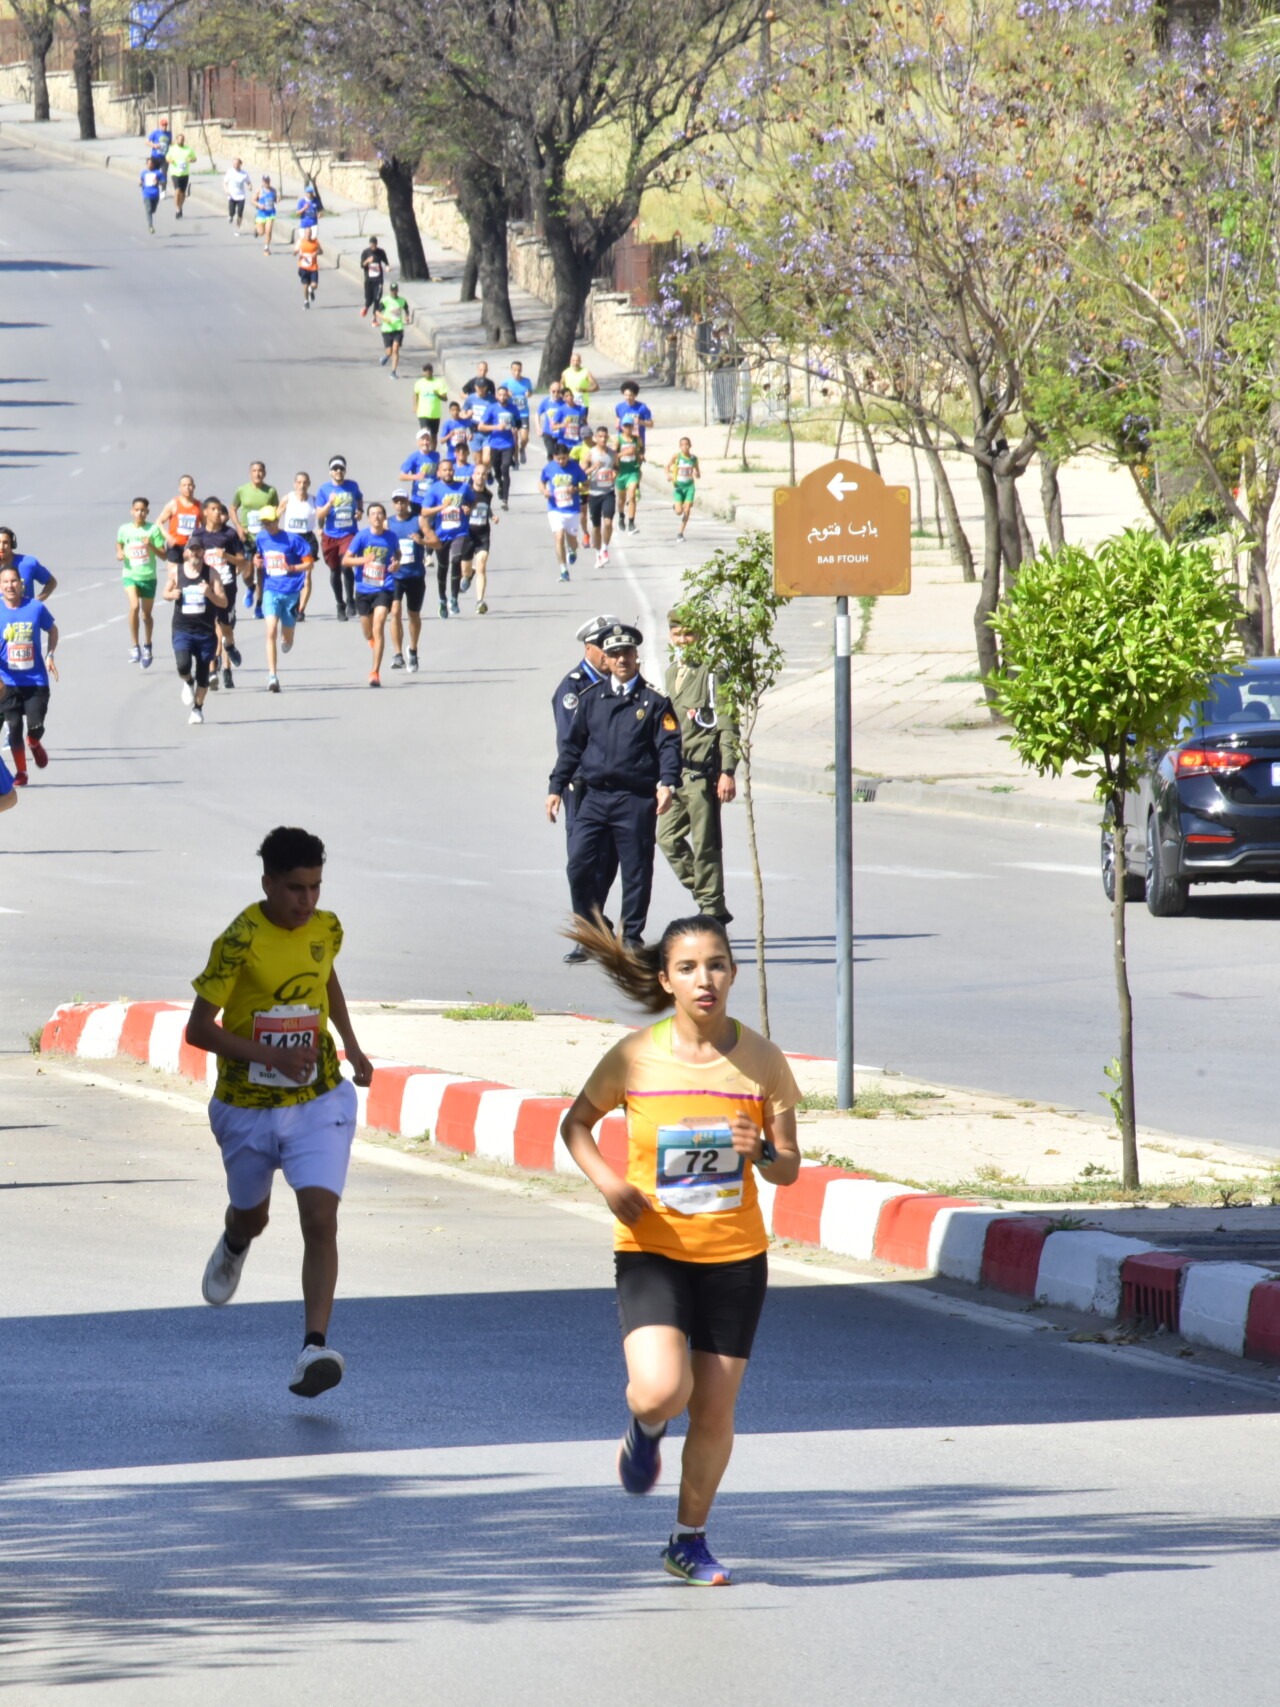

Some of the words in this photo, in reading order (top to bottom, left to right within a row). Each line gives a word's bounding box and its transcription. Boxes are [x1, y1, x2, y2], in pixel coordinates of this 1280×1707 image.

[807, 522, 841, 544] فتوح
[847, 520, 878, 538] باب
[817, 555, 835, 564] BAB
[837, 554, 869, 563] FTOUH
[14, 622, 32, 633] FEZ
[685, 1150, 719, 1173] 72
